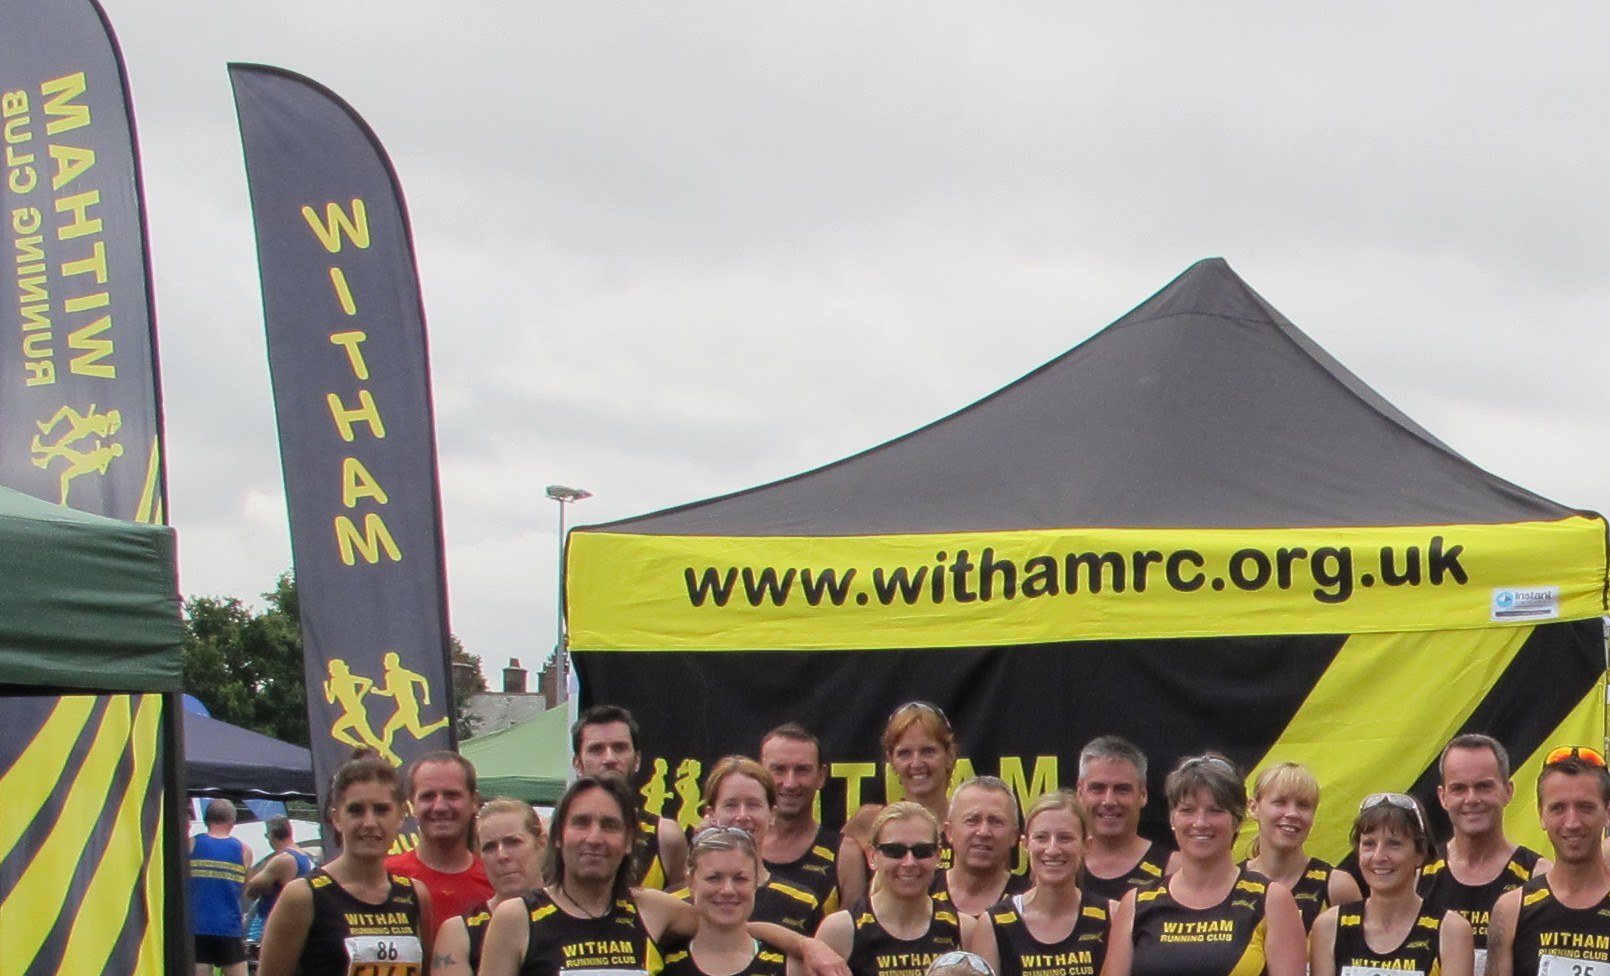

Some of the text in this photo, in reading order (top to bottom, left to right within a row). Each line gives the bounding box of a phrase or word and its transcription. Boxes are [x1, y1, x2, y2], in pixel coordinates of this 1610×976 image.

[301, 198, 402, 567] WITHAM
[684, 535, 1468, 608] www.withamrc.org.uk
[344, 912, 409, 925] WITHAM
[1162, 920, 1234, 934] WITHAM
[1160, 932, 1233, 943] RUNNING CLUB
[1539, 932, 1610, 950] WITHAM
[376, 940, 399, 961] 86
[562, 940, 633, 957] WITHAM
[1582, 950, 1609, 961] CLUB
[565, 955, 637, 968] RUNNING CLUB
[1020, 950, 1093, 967] WITHAM
[1068, 965, 1094, 976] CLUB
